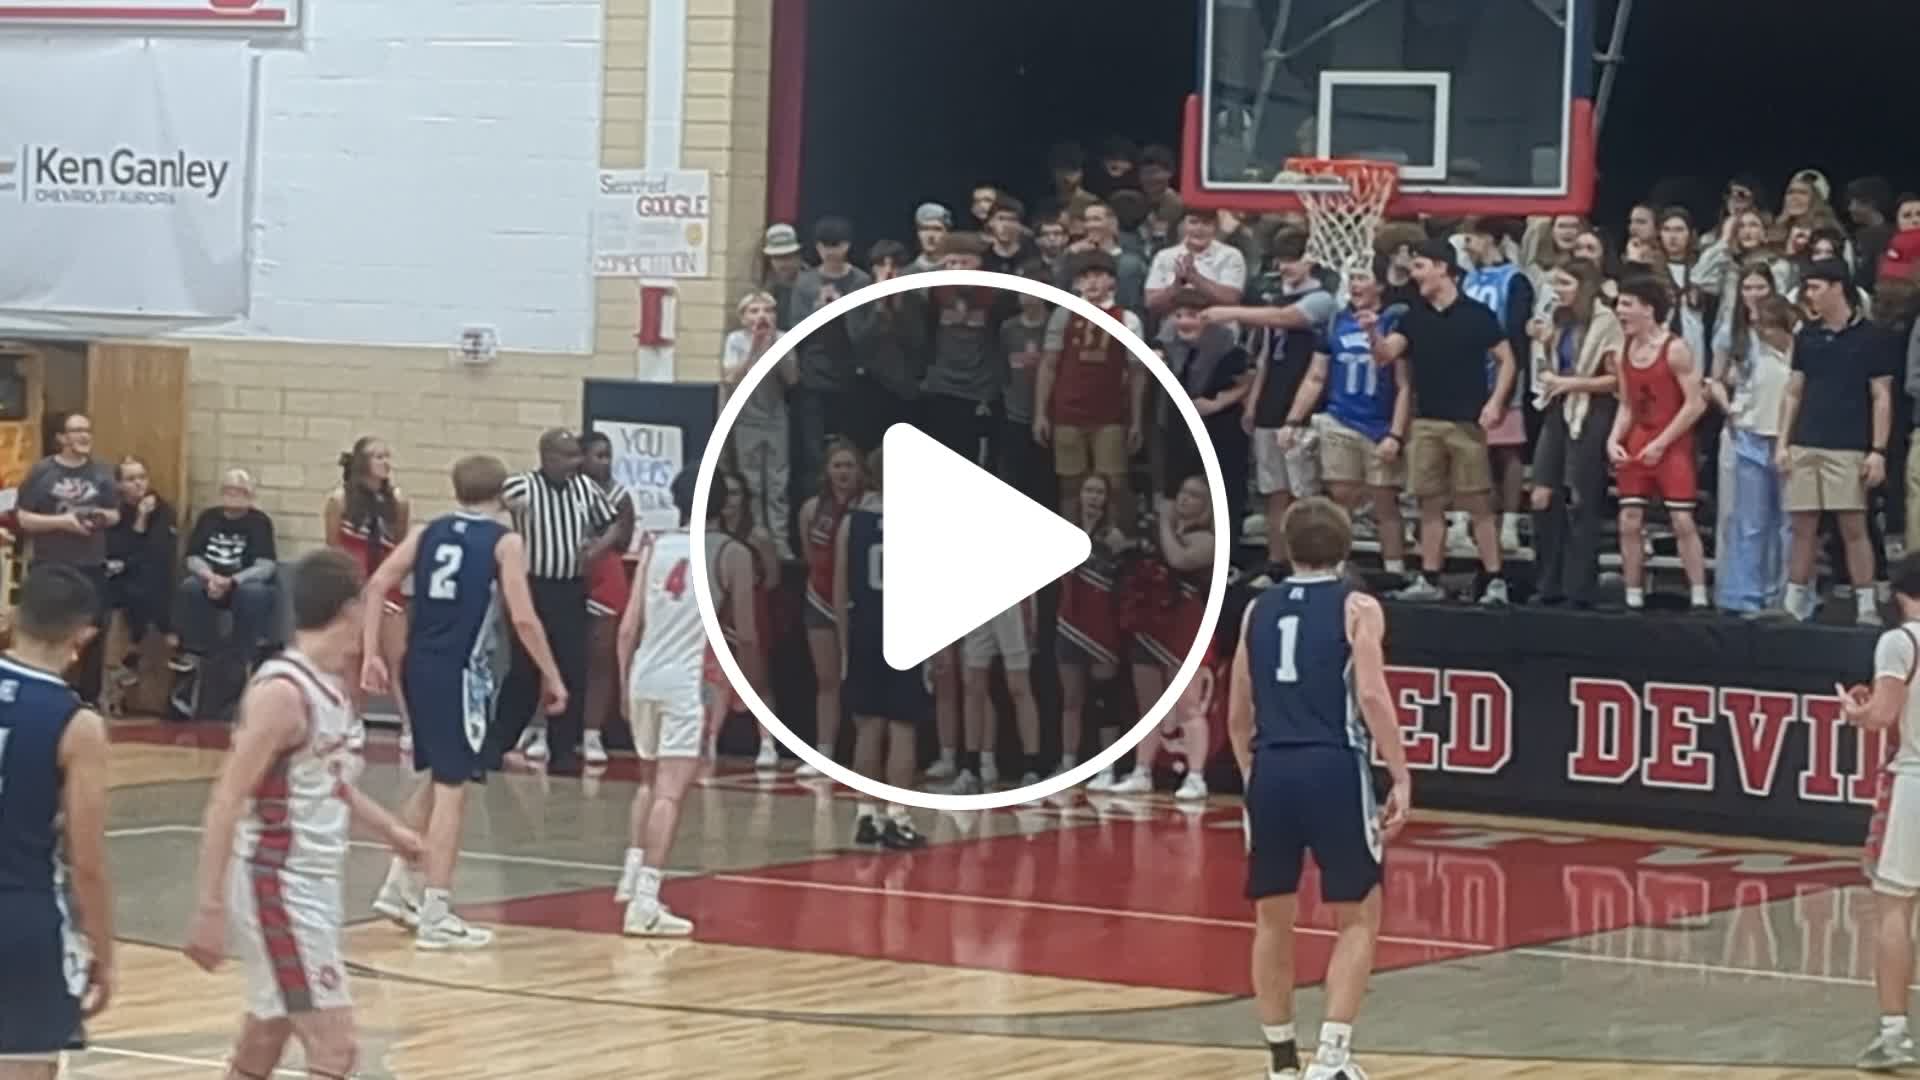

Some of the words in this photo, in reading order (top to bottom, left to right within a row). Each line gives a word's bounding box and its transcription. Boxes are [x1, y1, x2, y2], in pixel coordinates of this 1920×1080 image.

[35, 147, 103, 185] Ken
[110, 148, 229, 198] Ganley
[428, 544, 463, 600] 2
[664, 557, 689, 601] 4
[1276, 615, 1299, 682] 1
[1371, 665, 1512, 774] ED
